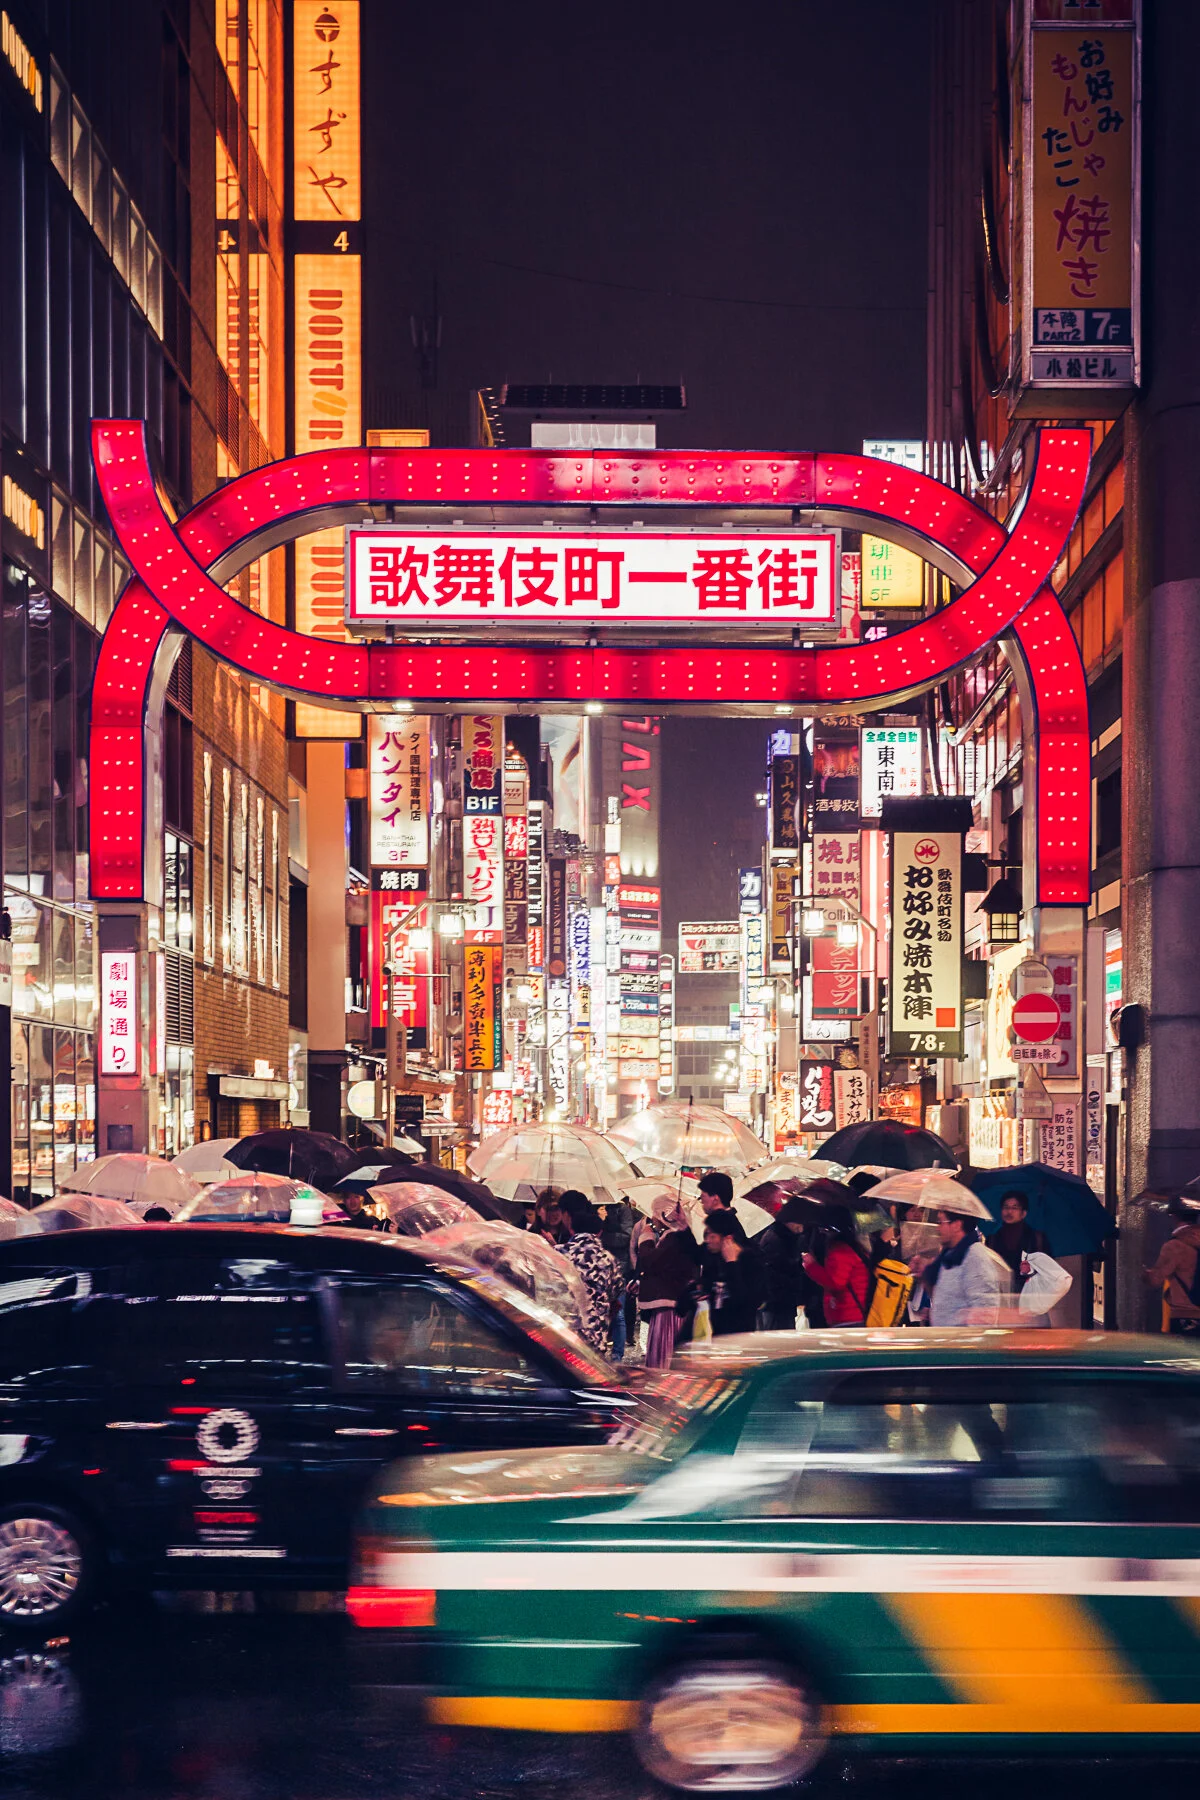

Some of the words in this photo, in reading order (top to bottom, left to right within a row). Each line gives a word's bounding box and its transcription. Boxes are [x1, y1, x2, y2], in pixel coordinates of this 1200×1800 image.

[1052, 53, 1106, 177] もんじゃ
[1078, 40, 1124, 133] お好み
[308, 50, 347, 215] すずや
[1042, 127, 1080, 187] たこ
[333, 231, 349, 252] 4
[1053, 194, 1111, 298] 焼き
[1043, 330, 1080, 341] PART2
[1092, 313, 1120, 340] 7F
[308, 289, 348, 440] DOUTOR
[1046, 357, 1117, 378] 小松ビル
[369, 545, 818, 609] 歌舞伎町一番街
[378, 731, 405, 828] バンタイ
[409, 732, 421, 822] タイ国料理専門店
[466, 796, 499, 810] B1F
[380, 871, 420, 890] 焼肉
[388, 850, 409, 861] 3F
[473, 931, 494, 942] 4F
[903, 865, 934, 1020] お好み焼本陣
[109, 962, 128, 1063] 劇場通り
[1013, 1049, 1057, 1060] 自転車を除く
